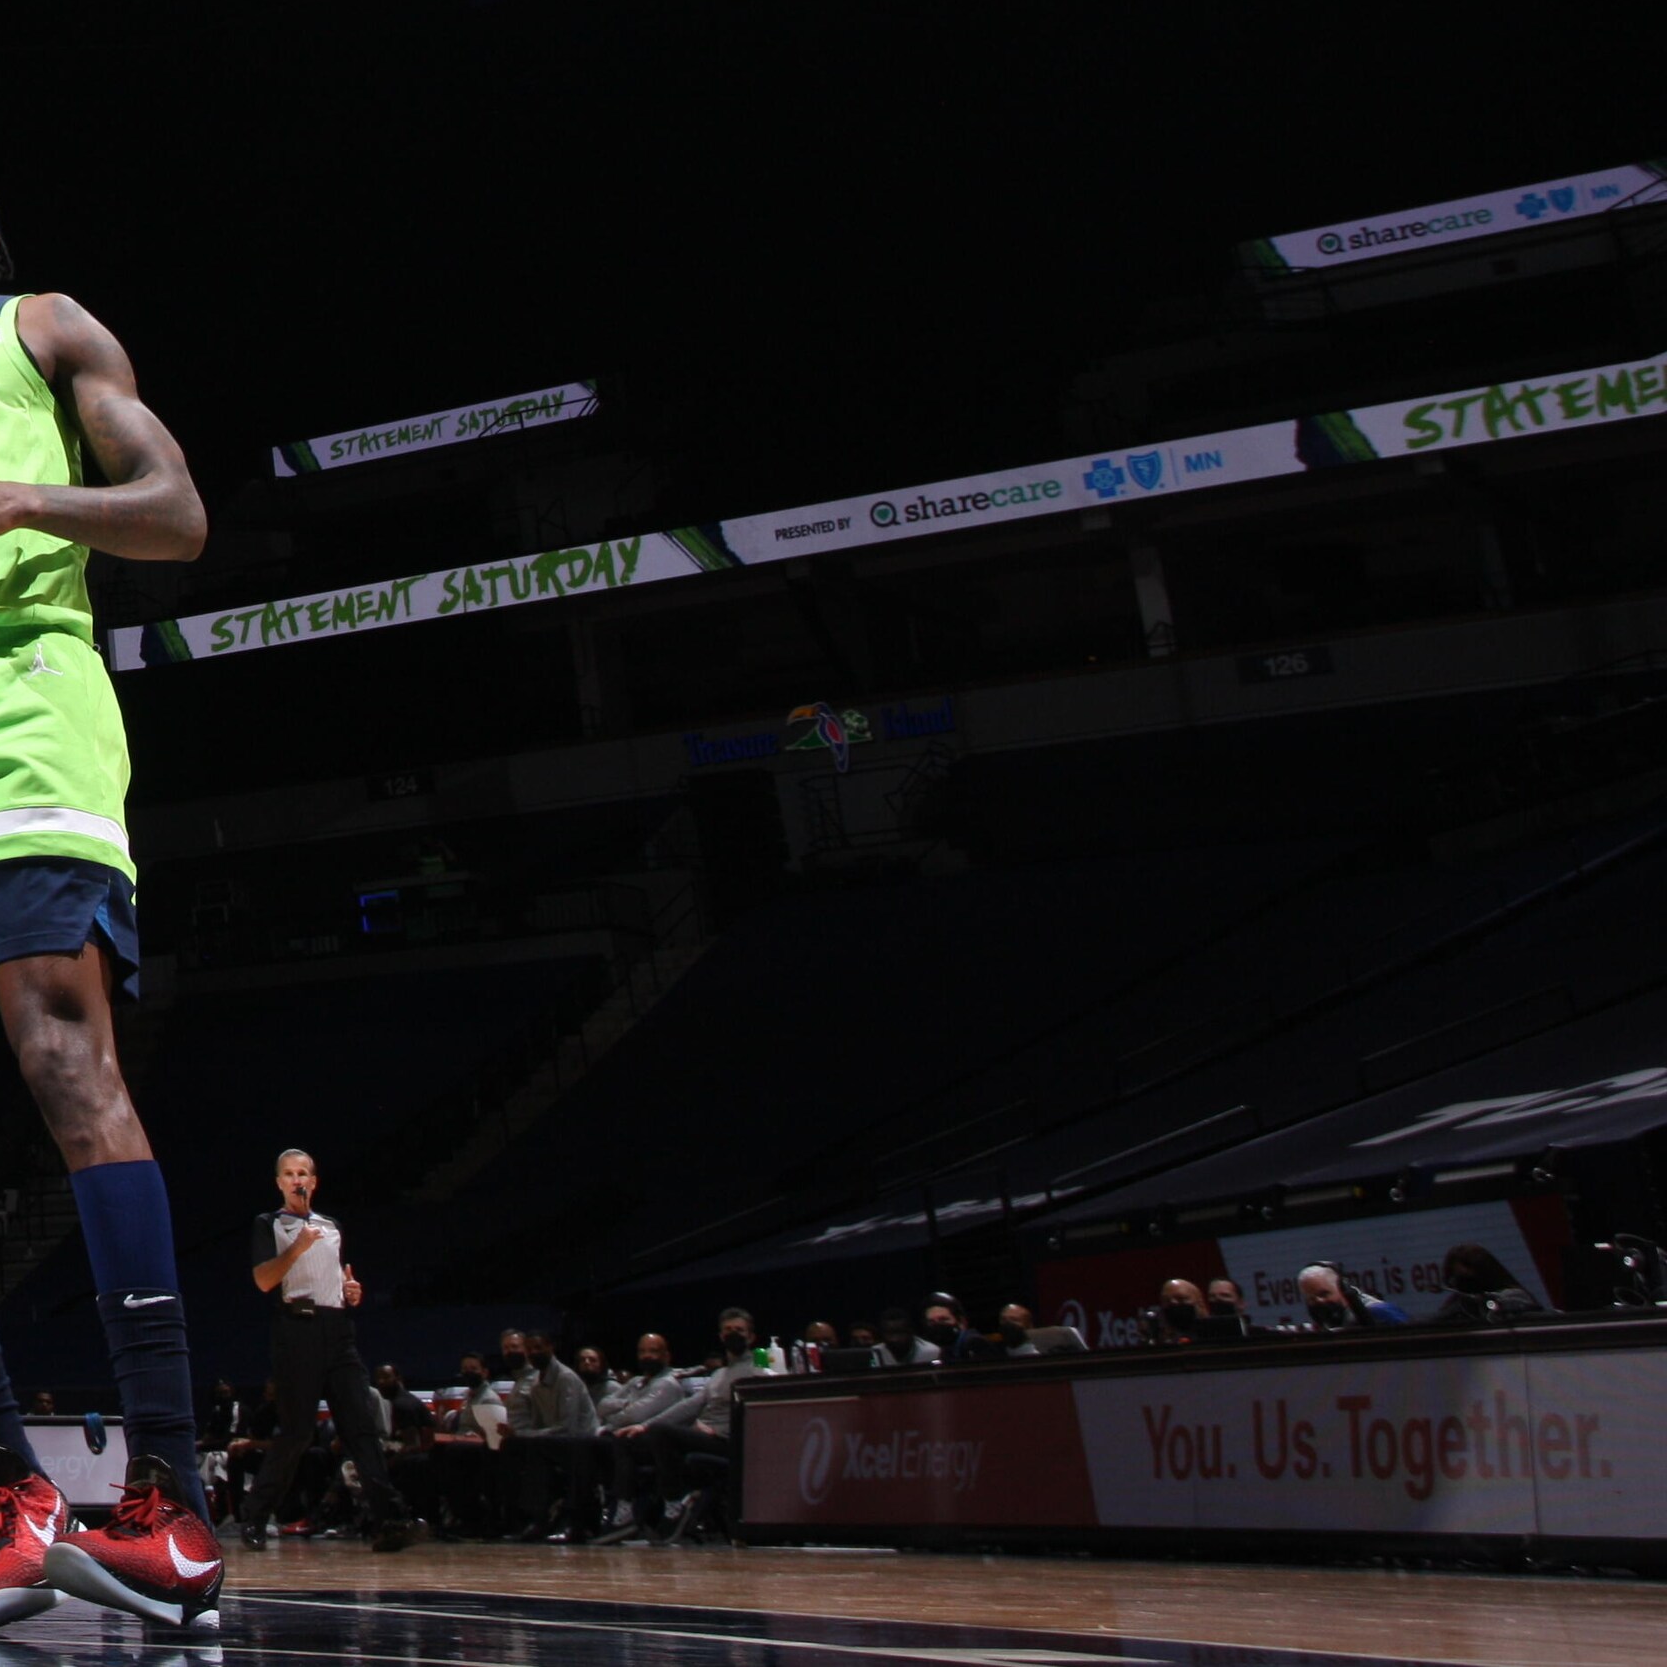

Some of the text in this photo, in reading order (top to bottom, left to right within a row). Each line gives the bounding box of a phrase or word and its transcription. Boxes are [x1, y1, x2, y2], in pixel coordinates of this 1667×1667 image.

[1349, 208, 1493, 250] sharecare
[330, 390, 566, 460] STATEMENT SATURDAY
[1403, 365, 1667, 449] STATEME
[774, 518, 834, 542] PRESENTED
[904, 480, 1062, 523] sharecare
[1184, 451, 1223, 473] MN
[211, 537, 641, 651] STATEMENT SATURDAY
[1264, 651, 1308, 676] 126
[383, 775, 419, 797] 124
[1142, 1404, 1237, 1481] You.
[1253, 1397, 1330, 1481] Us.
[1336, 1392, 1613, 1501] Together.
